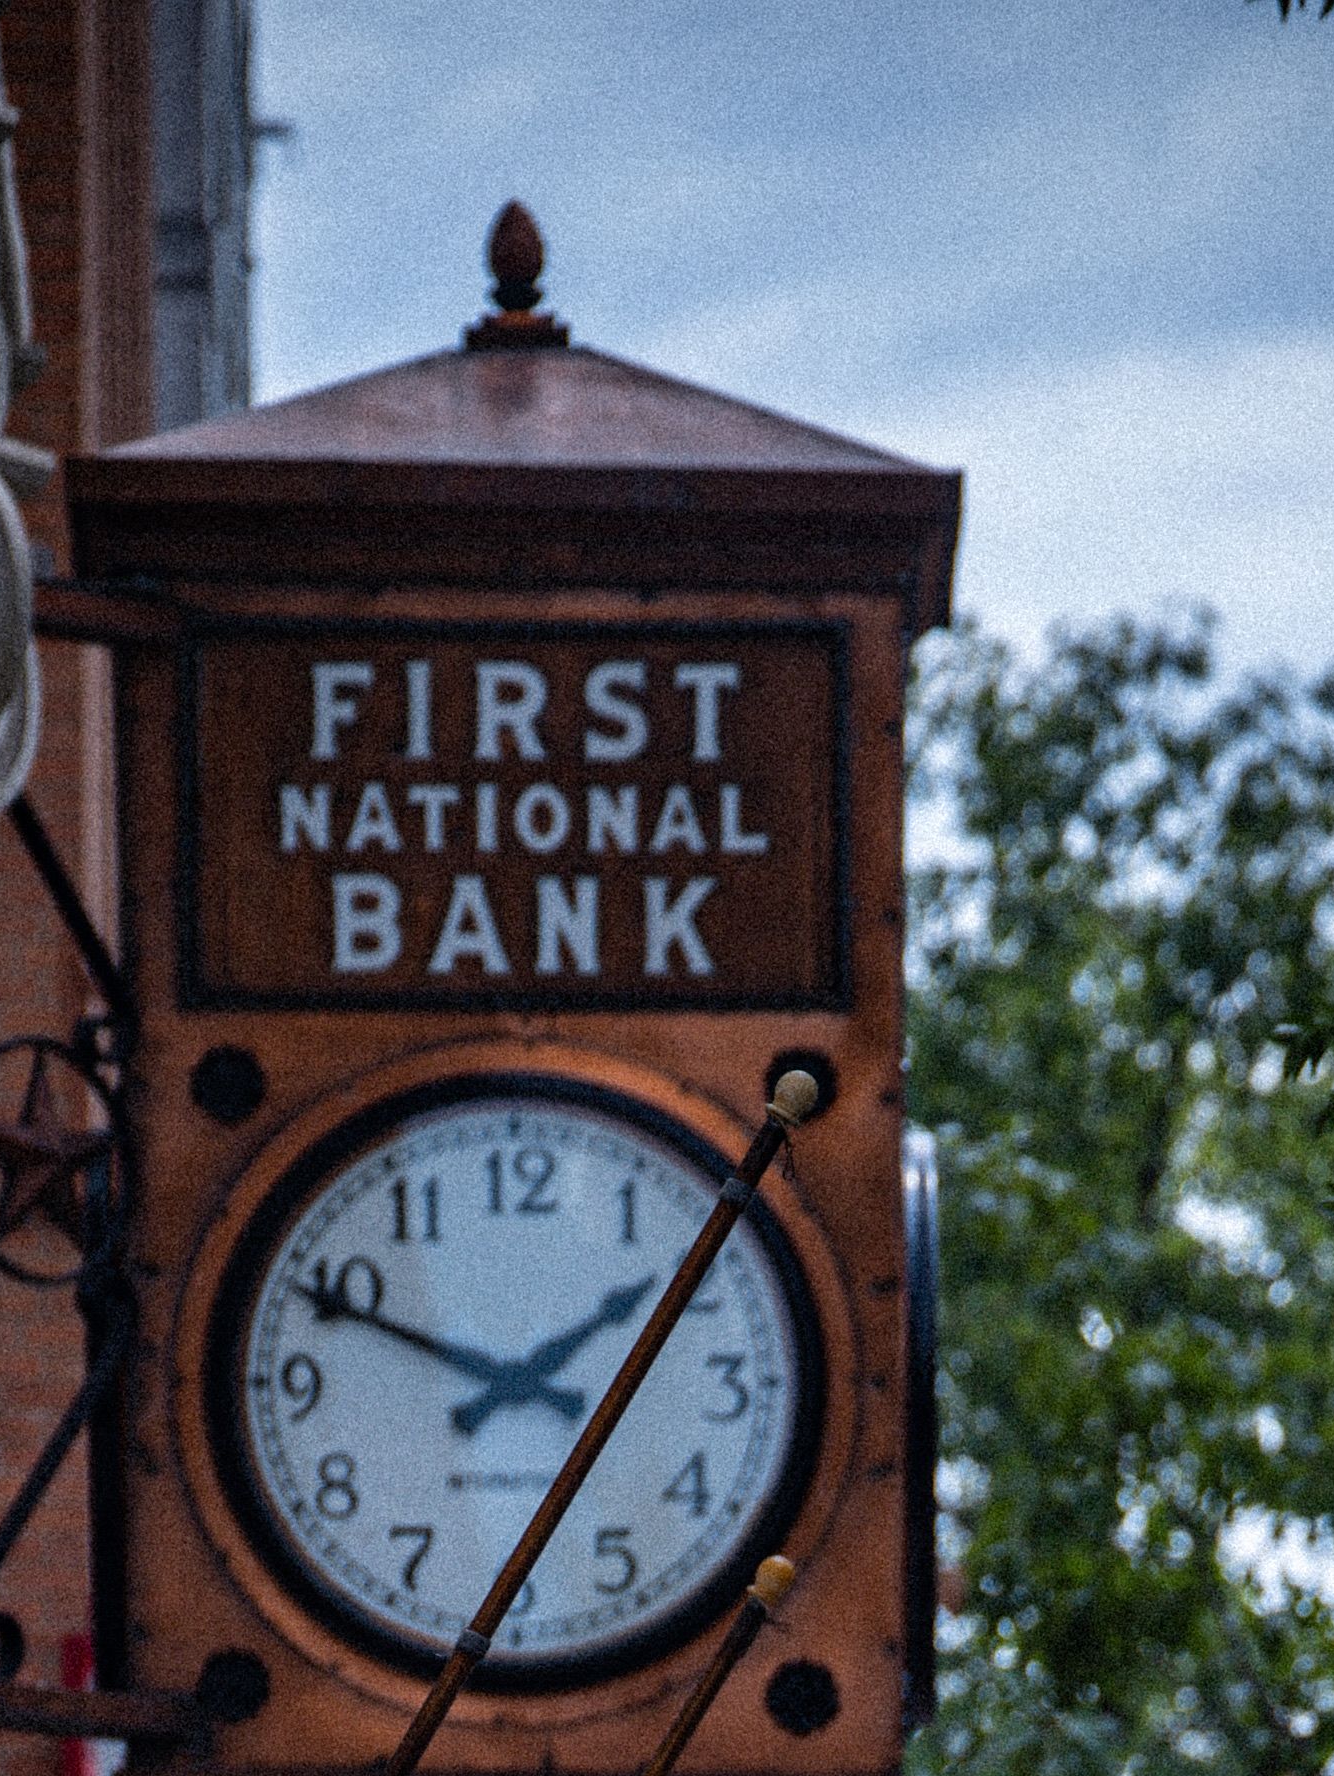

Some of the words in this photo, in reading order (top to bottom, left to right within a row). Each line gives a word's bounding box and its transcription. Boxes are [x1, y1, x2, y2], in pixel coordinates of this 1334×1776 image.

[309, 660, 742, 763] FIRST
[278, 780, 770, 855] NATIONAL
[330, 872, 715, 978] BANK
[391, 1178, 442, 1244] 11
[487, 1147, 557, 1215] 12
[620, 1179, 638, 1243] 1
[313, 1255, 384, 1320] 10
[280, 1353, 323, 1420] 9
[705, 1353, 748, 1421] 3
[316, 1453, 359, 1520] 8
[661, 1450, 708, 1518] 4
[389, 1526, 434, 1591] 7
[593, 1528, 638, 1594] 5
